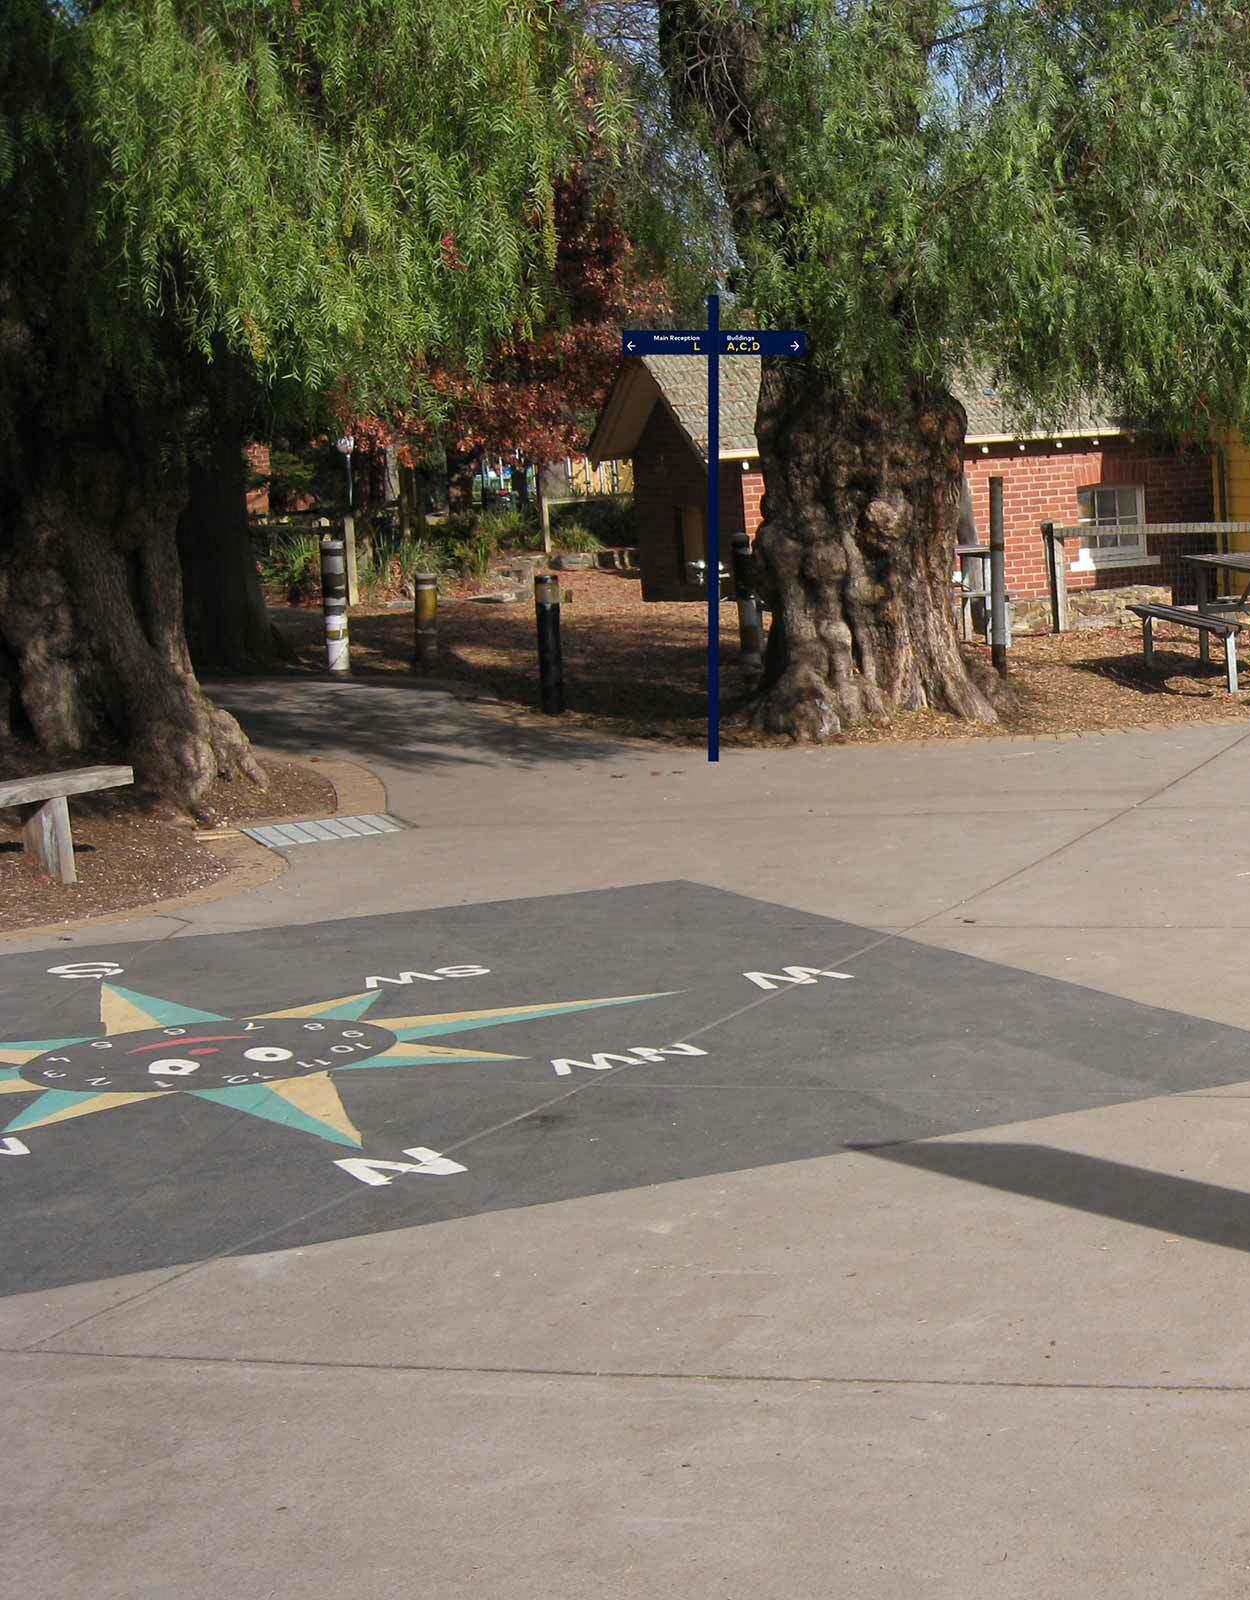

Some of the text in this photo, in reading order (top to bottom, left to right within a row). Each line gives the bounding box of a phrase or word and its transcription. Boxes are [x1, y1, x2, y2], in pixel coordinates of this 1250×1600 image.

[670, 334, 701, 342] Reception
[726, 334, 755, 343] Buildings
[693, 342, 701, 351] L
[47, 961, 124, 979] S
[333, 1146, 468, 1187] N
